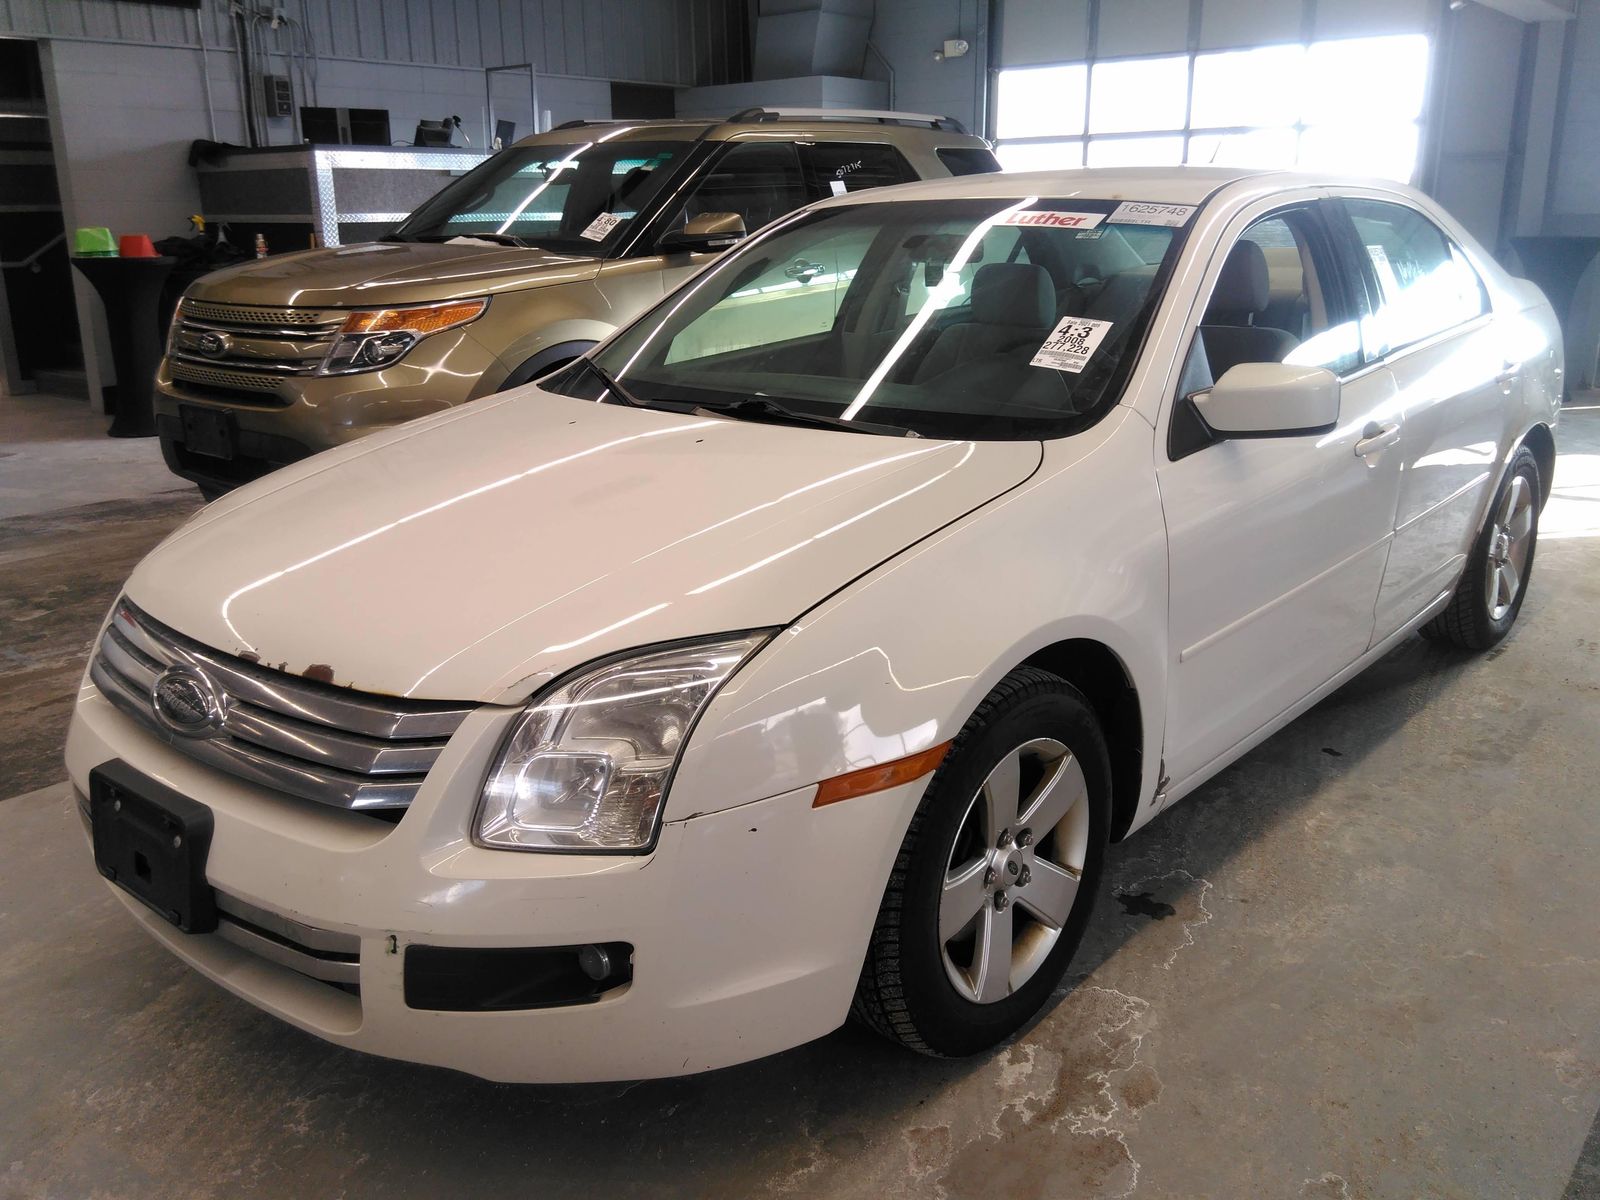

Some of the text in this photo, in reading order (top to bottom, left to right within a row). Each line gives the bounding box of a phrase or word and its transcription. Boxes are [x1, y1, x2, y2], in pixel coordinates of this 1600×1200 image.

[1121, 203, 1188, 216] 1625748
[1006, 212, 1088, 226] Luther
[1057, 325, 1093, 338] 4:3
[1056, 335, 1086, 346] 2008
